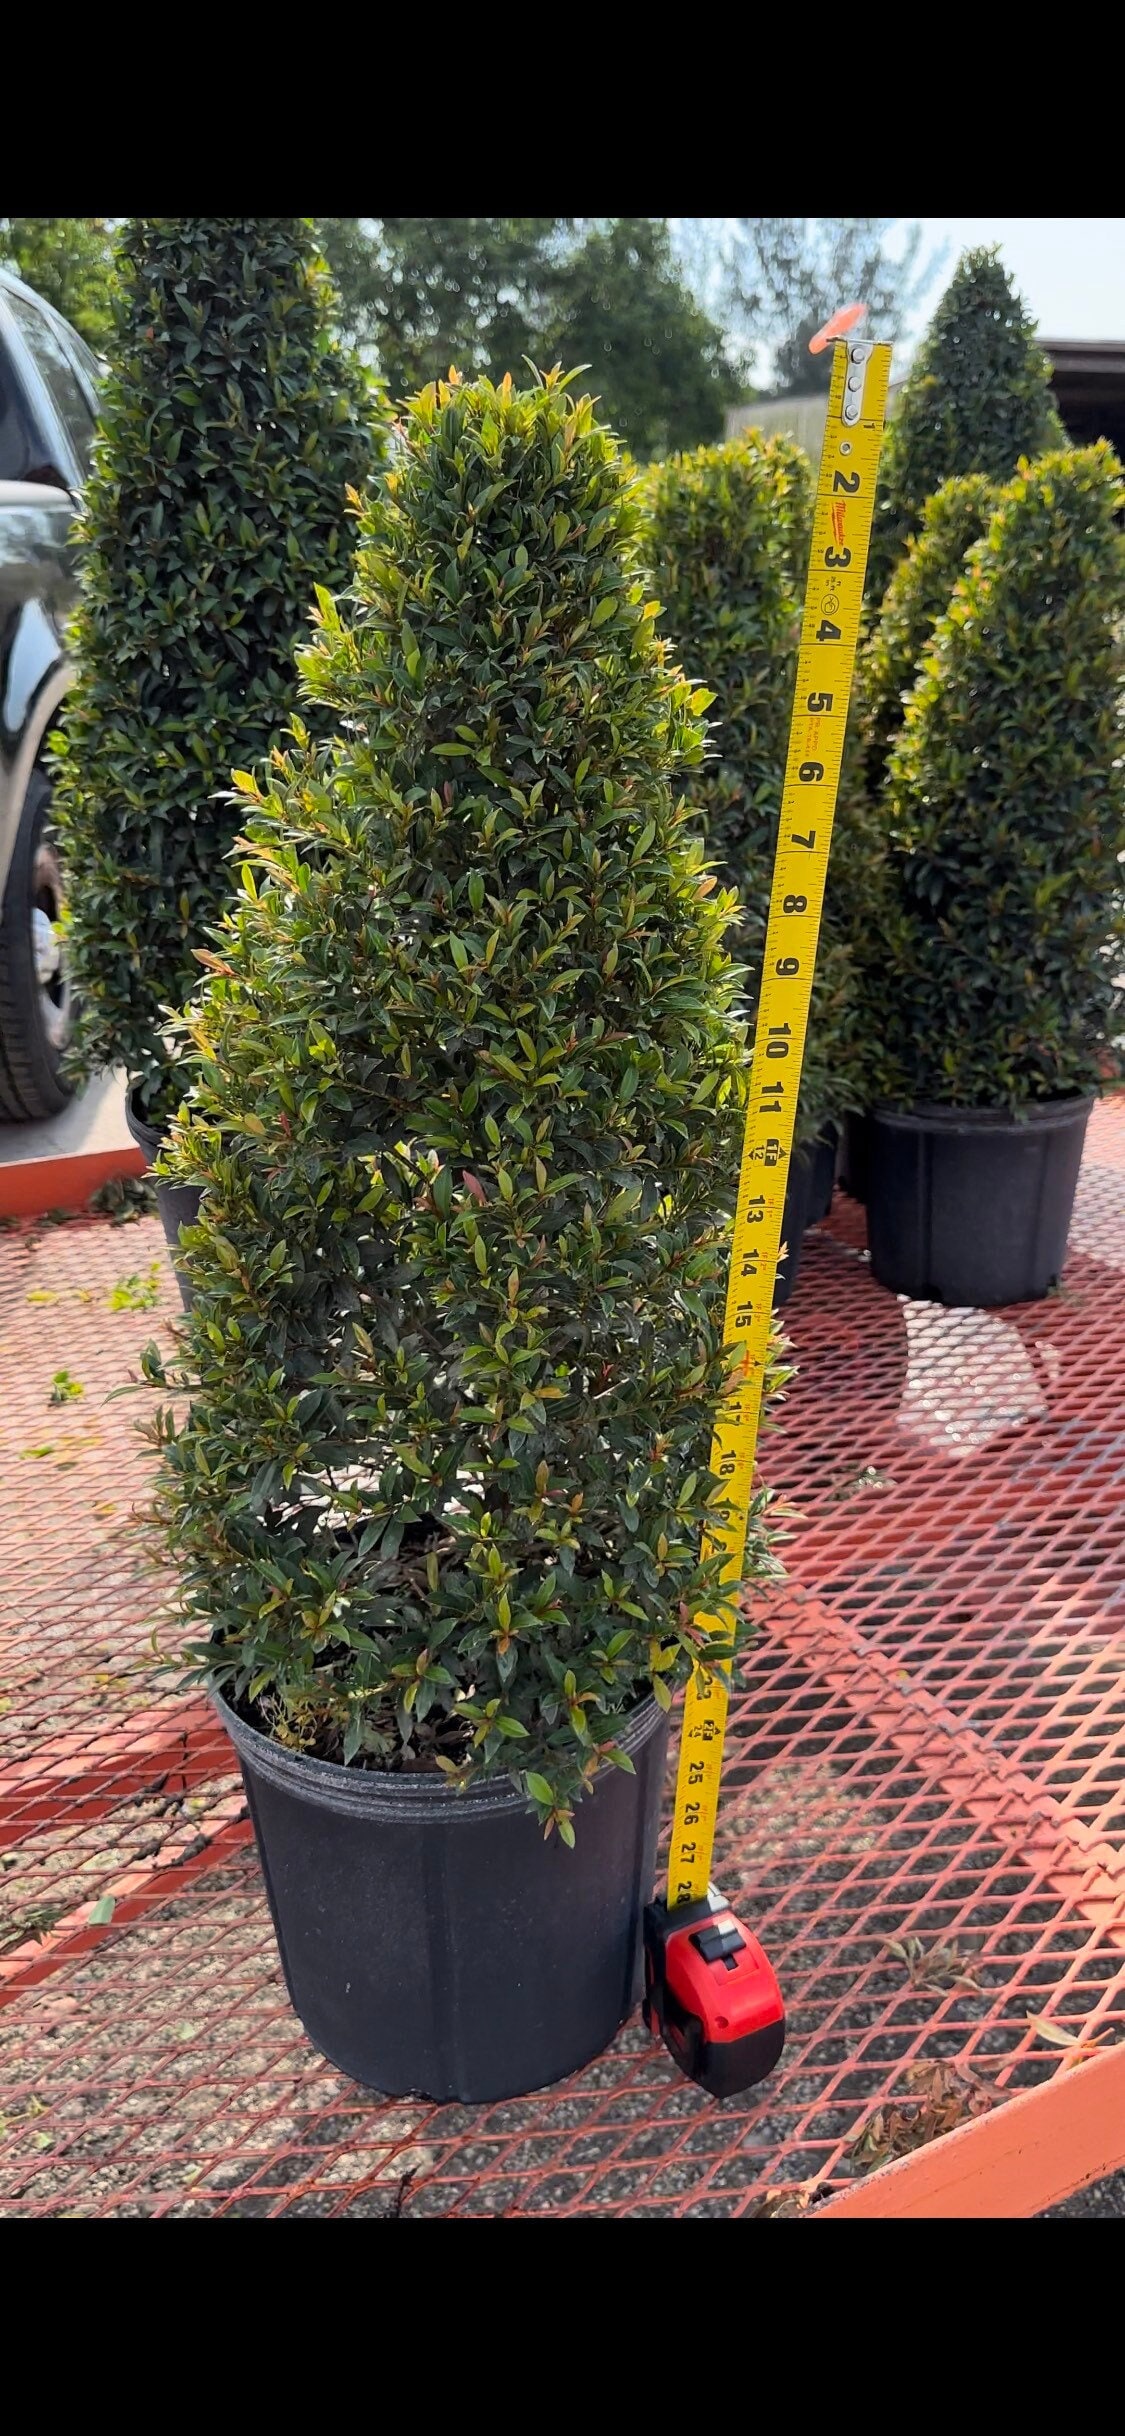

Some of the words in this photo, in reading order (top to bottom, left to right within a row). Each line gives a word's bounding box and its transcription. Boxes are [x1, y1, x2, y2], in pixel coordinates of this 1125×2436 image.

[833, 470, 860, 492] 2
[824, 546, 851, 568] 3
[816, 620, 841, 642] 4
[807, 692, 833, 712] 5
[798, 762, 824, 782] 6
[791, 830, 816, 849] 7
[782, 894, 808, 914] 8
[776, 958, 800, 976] 9
[766, 1022, 792, 1058] 10
[759, 1081, 784, 1112] 11
[754, 1145, 764, 1160] 12
[746, 1194, 766, 1224] 13
[741, 1248, 760, 1276] 14
[736, 1301, 753, 1328] 15
[720, 1450, 736, 1476] 18
[688, 1760, 704, 1784] 25
[684, 1802, 700, 1826] 26
[680, 1842, 696, 1864] 27
[676, 1880, 692, 1904] 28
